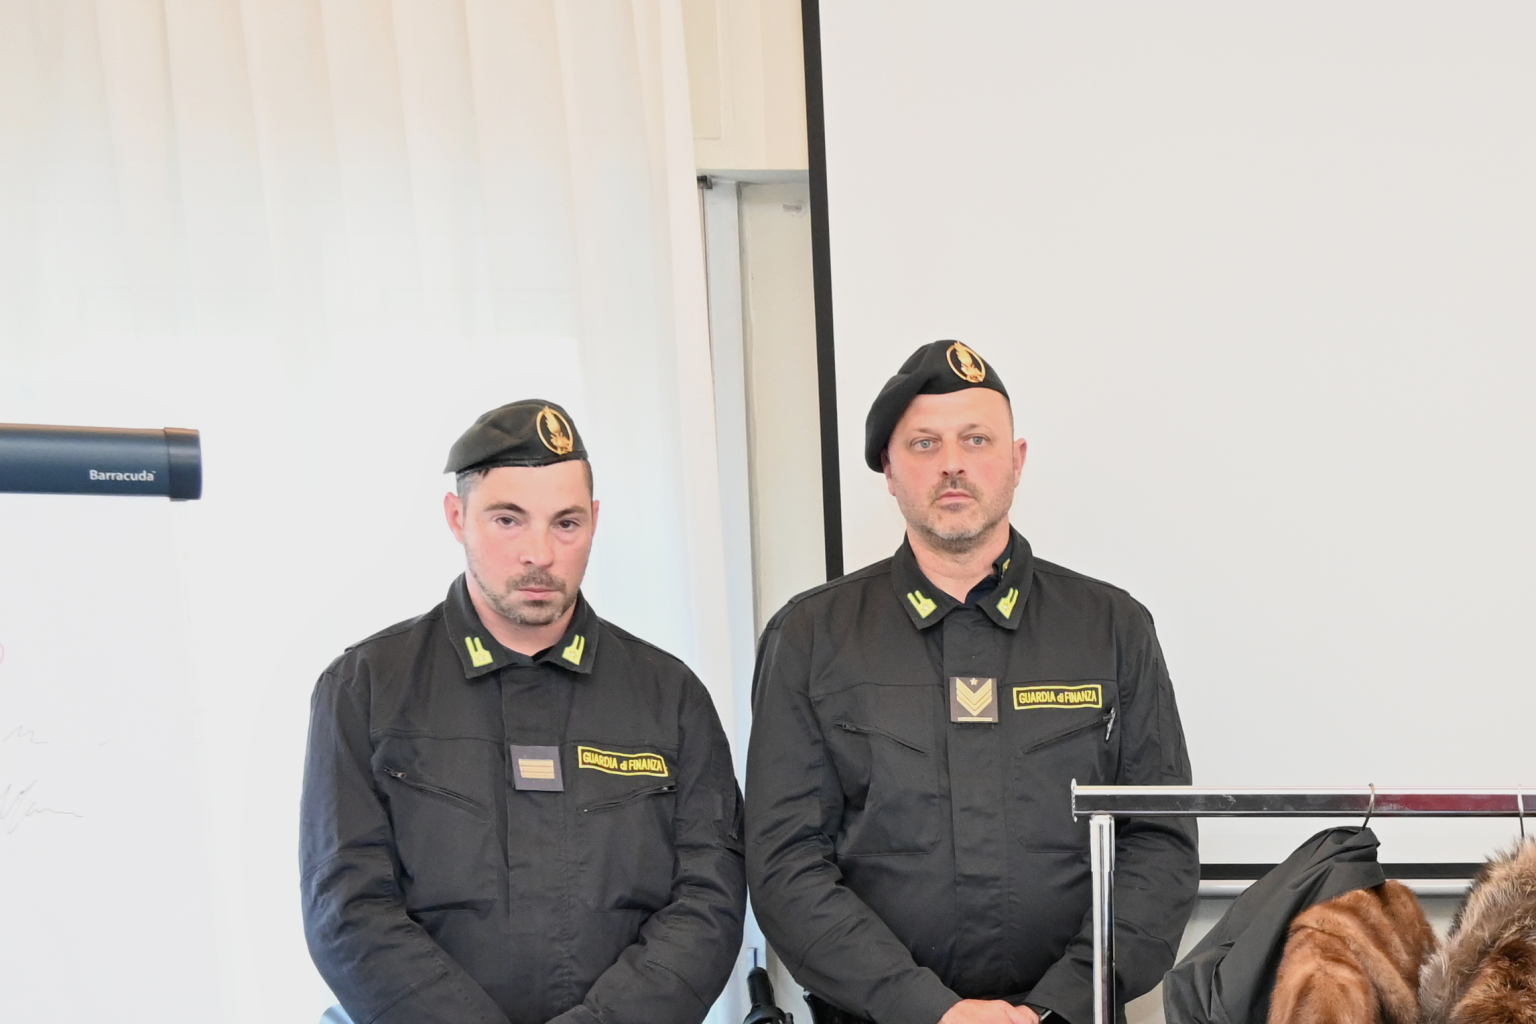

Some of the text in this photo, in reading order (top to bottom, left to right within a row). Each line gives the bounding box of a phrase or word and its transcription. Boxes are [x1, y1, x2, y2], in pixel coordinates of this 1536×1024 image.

[1018, 689, 1097, 704] GUARDIA di FINANZA
[582, 751, 663, 772] GUARDIA di FINANZA
